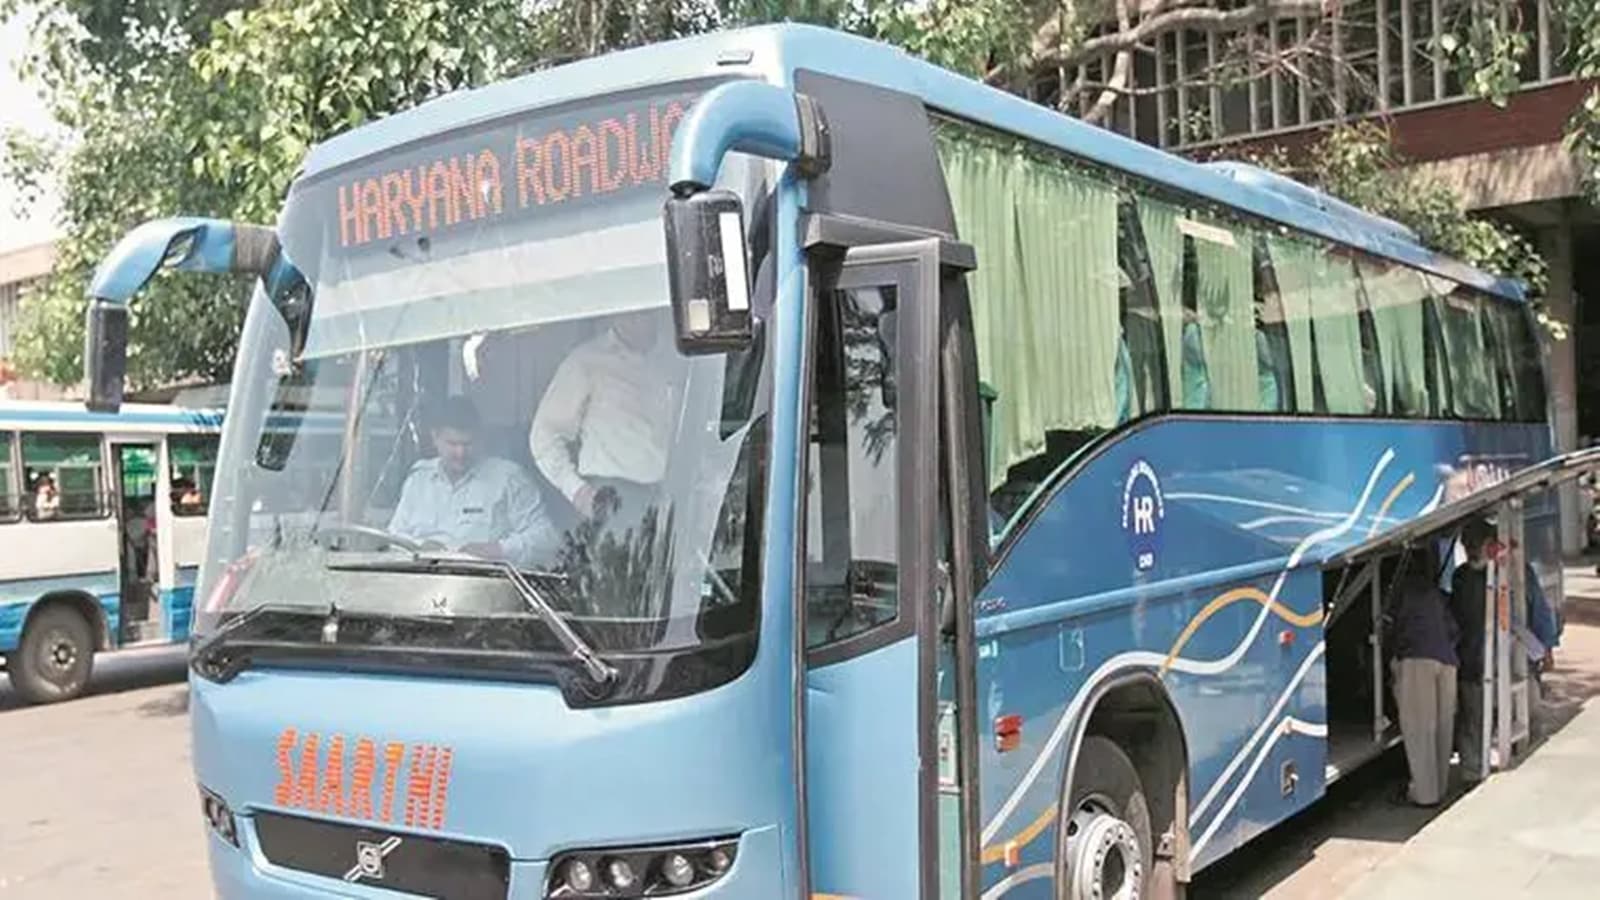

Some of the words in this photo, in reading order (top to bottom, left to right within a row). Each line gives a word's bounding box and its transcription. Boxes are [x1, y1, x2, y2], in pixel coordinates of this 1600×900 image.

[338, 148, 502, 248] HARYANA
[1133, 495, 1155, 534] HR
[273, 727, 453, 830] SAARTHI
